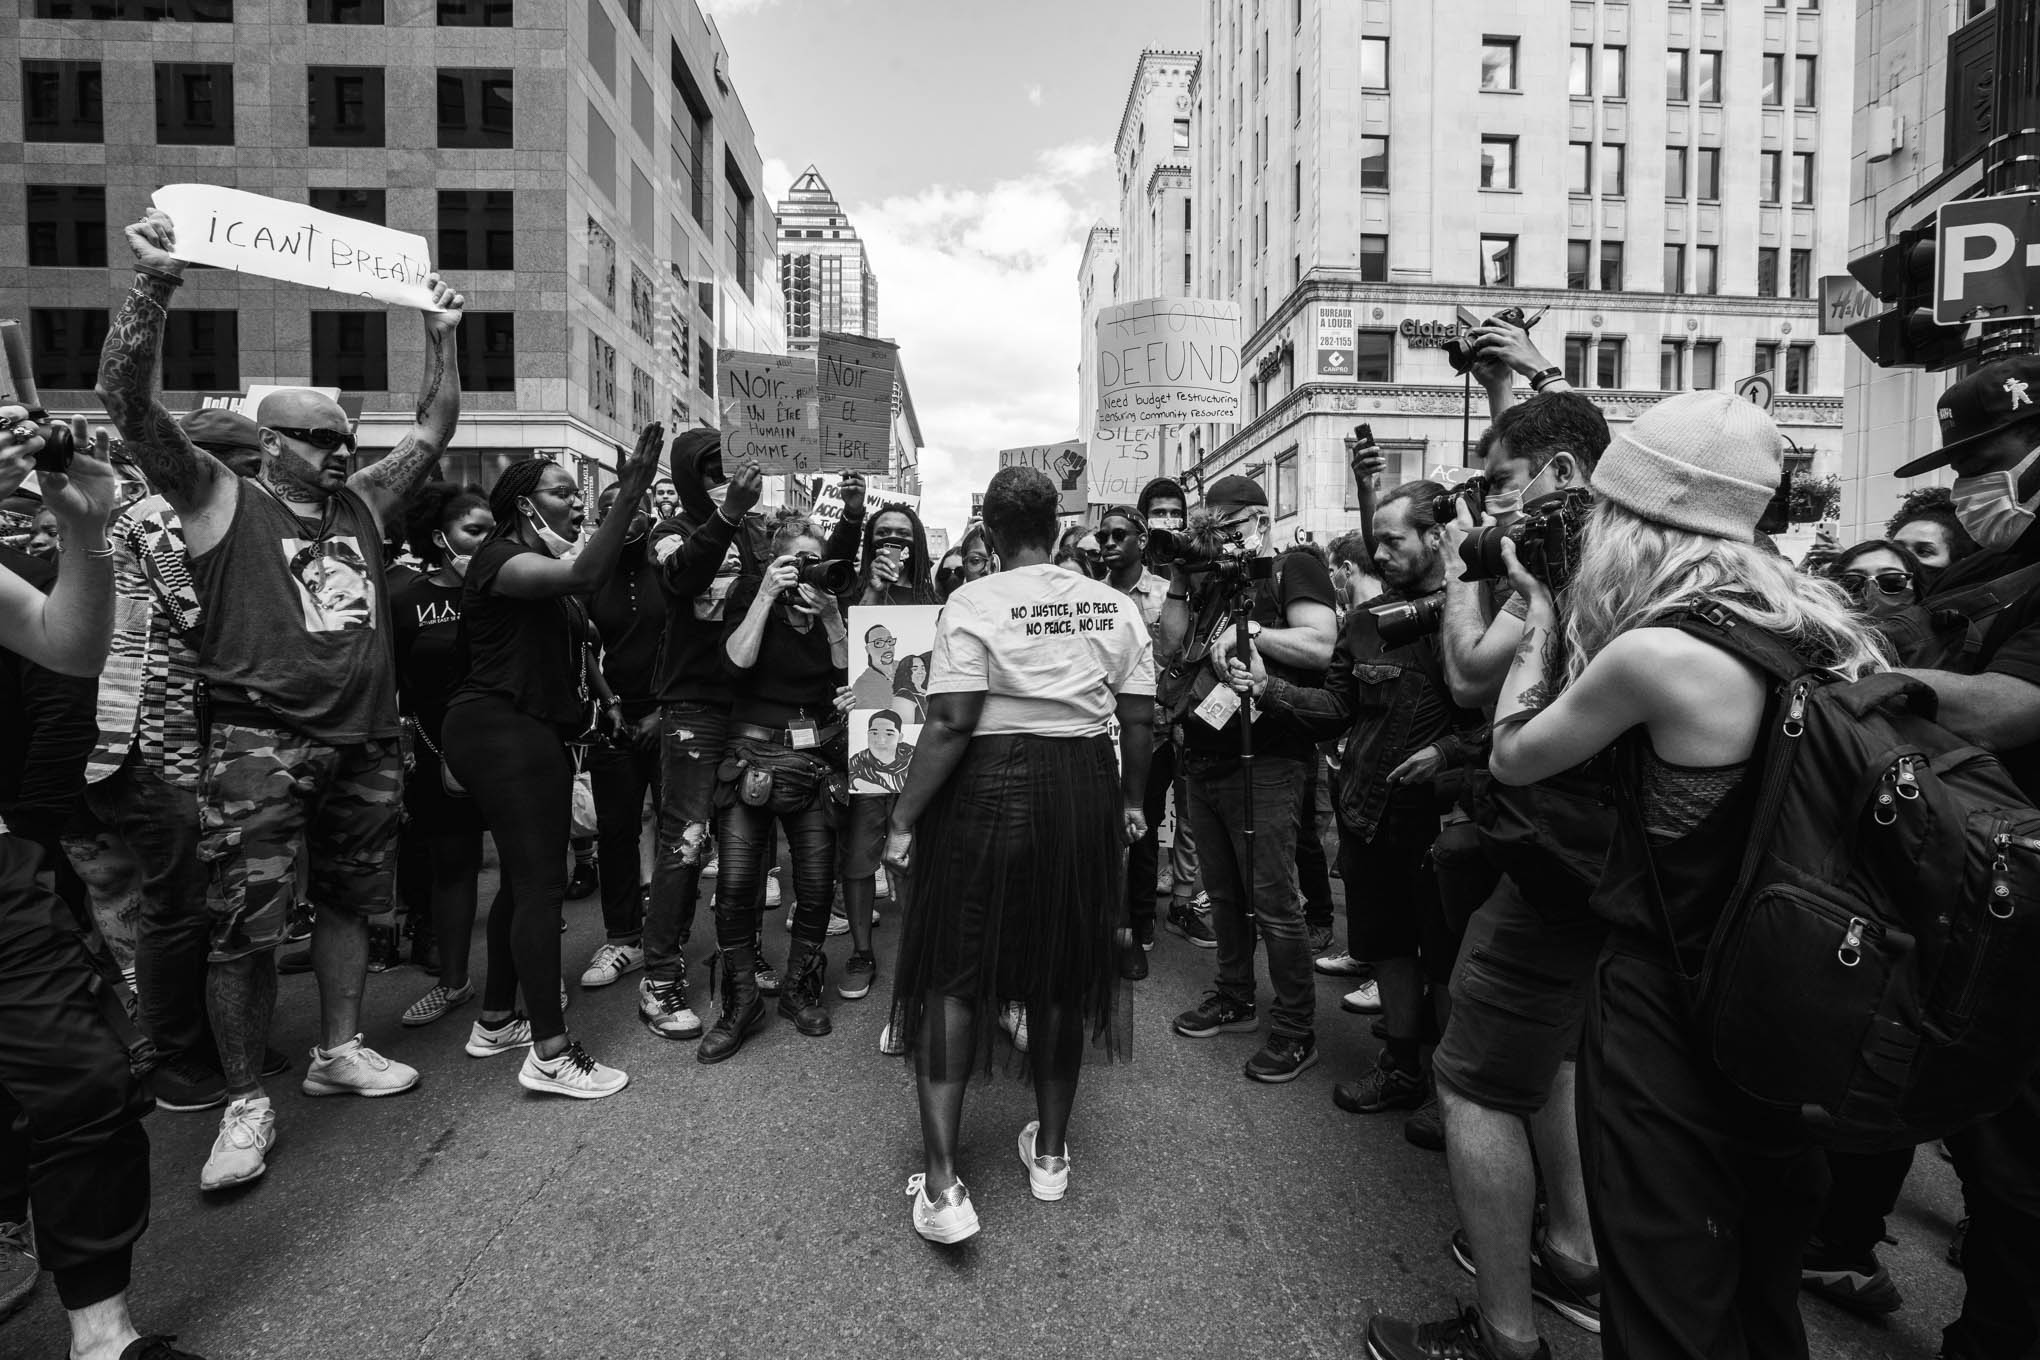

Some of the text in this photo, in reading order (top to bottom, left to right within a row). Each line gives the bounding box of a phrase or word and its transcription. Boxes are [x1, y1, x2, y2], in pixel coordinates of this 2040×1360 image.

[226, 223, 322, 263] CANT
[1115, 299, 1236, 340] REFORM
[1320, 308, 1352, 318] BUREAUX
[1327, 318, 1352, 329] LOUER
[1400, 318, 1462, 338] Global
[1320, 336, 1352, 347] 282-1155
[1101, 341, 1239, 387] DEFUND
[1104, 393, 1129, 410] Need
[1135, 392, 1172, 410] budget
[748, 421, 796, 439] HUMAIN
[1115, 443, 1150, 460] IS
[1011, 601, 1119, 620] NO JUSTICE, NO PEACE
[1026, 618, 1114, 636] NO PEACE, NO LIFE
[1210, 616, 1229, 643] Canon
